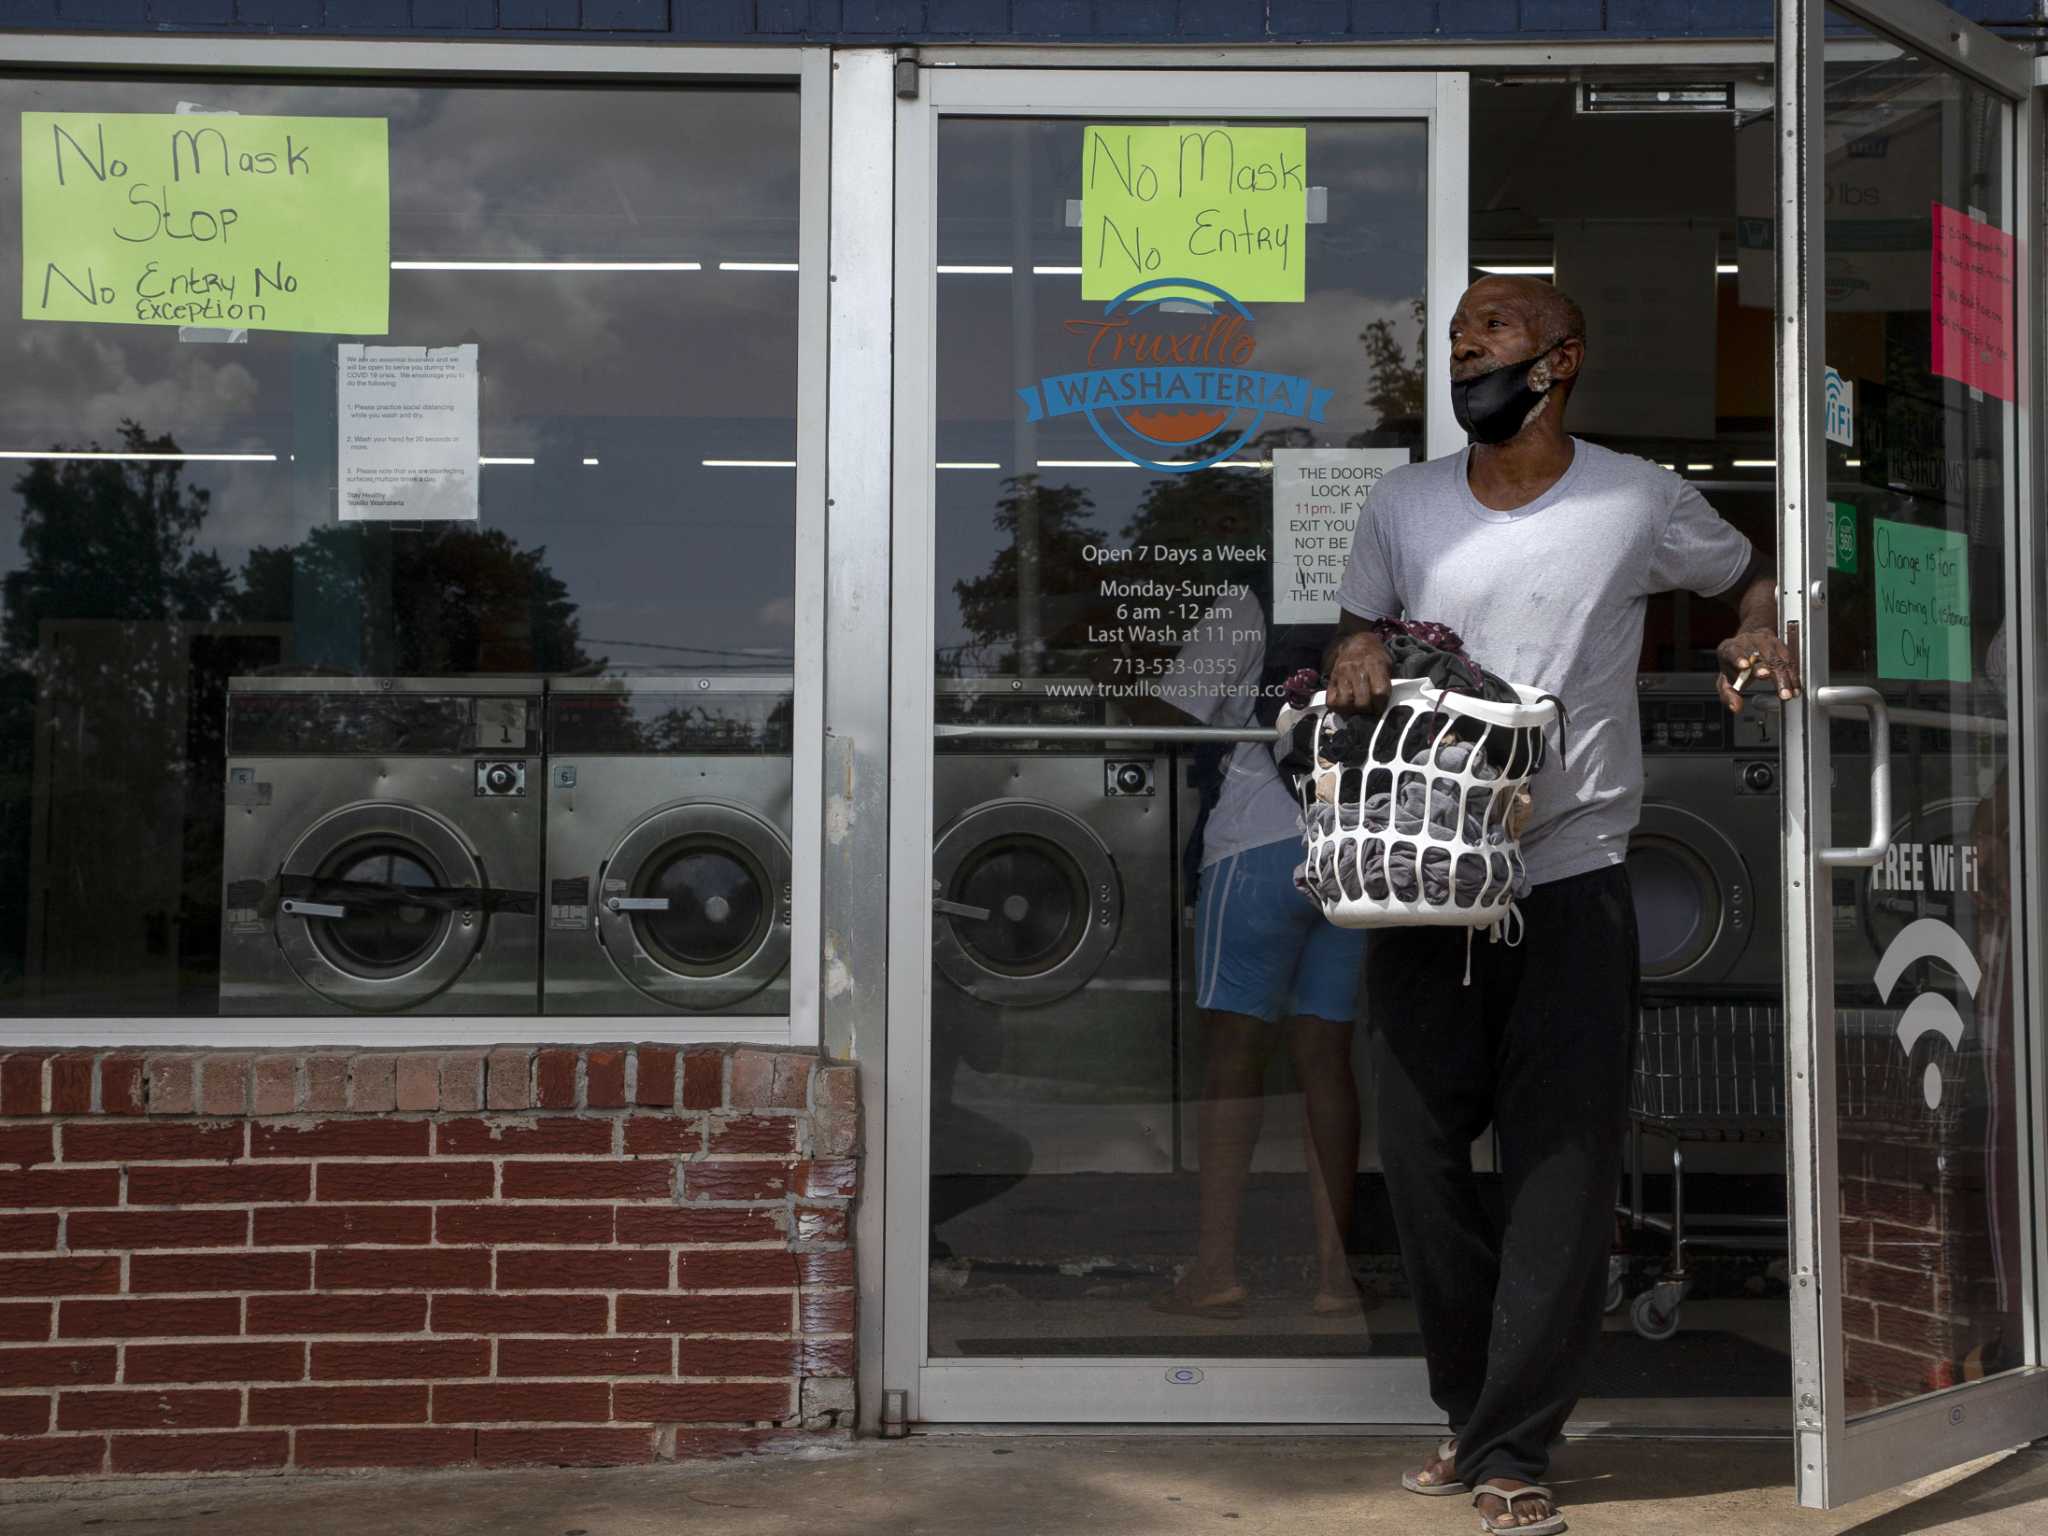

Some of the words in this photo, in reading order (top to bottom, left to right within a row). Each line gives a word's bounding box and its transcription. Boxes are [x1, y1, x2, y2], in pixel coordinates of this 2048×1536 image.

[54, 123, 128, 186] No
[172, 128, 309, 182] Mask
[1090, 131, 1158, 202] No
[1179, 130, 1304, 198] Mask
[113, 183, 238, 243] Stop
[1099, 215, 1161, 274] No
[42, 262, 115, 309] No
[255, 261, 297, 297] No
[135, 298, 265, 322] Exception
[1063, 314, 1257, 369] Truxillo
[1056, 371, 1294, 410] WASHATERIA
[1298, 467, 1327, 479] THE
[1331, 467, 1384, 480] DOORS
[1311, 485, 1350, 497] LOCK
[1354, 485, 1372, 497] AT
[1295, 503, 1336, 517] 11pm.
[1340, 503, 1353, 515] IF
[1289, 519, 1320, 532] EXIT
[1324, 519, 1355, 532] YOU
[1295, 537, 1324, 550] NOT
[1328, 537, 1348, 549] BE
[1082, 545, 1132, 566] Open
[1138, 545, 1149, 561] 7
[1154, 545, 1198, 566] Days
[1202, 548, 1213, 561] a
[1216, 544, 1267, 561] Week
[1293, 554, 1314, 567] TO
[1876, 526, 1921, 585] Change
[1295, 571, 1337, 584] UNTIL
[1100, 580, 1249, 601] Monday-Sunday
[1290, 589, 1320, 602] THE
[1116, 604, 1128, 620] 6
[1132, 608, 1161, 620] am
[1204, 608, 1233, 620] am
[1881, 587, 1928, 625] Washing
[1088, 626, 1124, 642] Last
[1128, 625, 1177, 642] Wash
[1182, 628, 1200, 642] at
[1206, 627, 1226, 642] 11
[1232, 630, 1262, 647] pm
[1112, 658, 1238, 676] 713-533-0355
[1045, 681, 1286, 697] wwwtruxillowashateria.co
[1872, 843, 1924, 891] FREE
